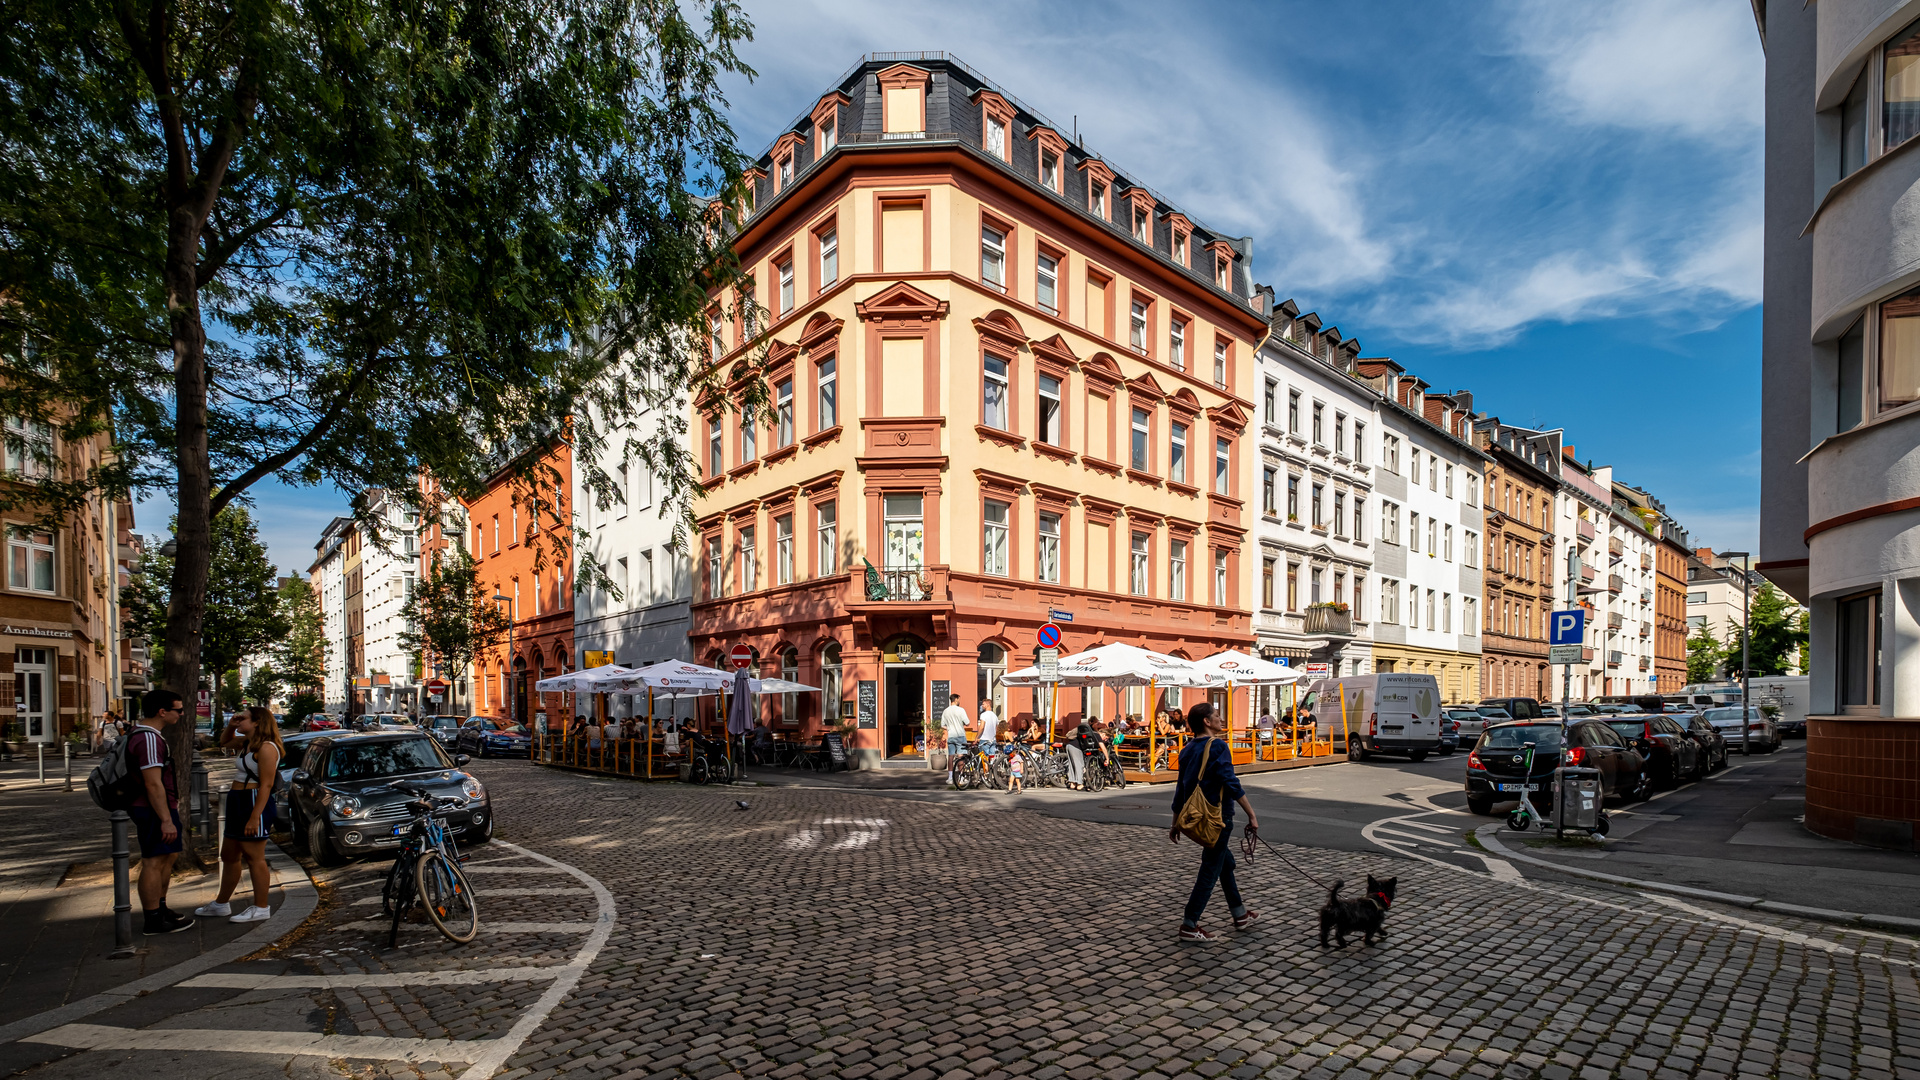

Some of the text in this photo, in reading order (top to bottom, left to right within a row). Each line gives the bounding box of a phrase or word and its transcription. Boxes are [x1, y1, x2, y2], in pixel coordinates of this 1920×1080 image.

[4, 625, 73, 638] Annabatterie
[1558, 614, 1576, 640] P
[898, 644, 912, 654] TUB
